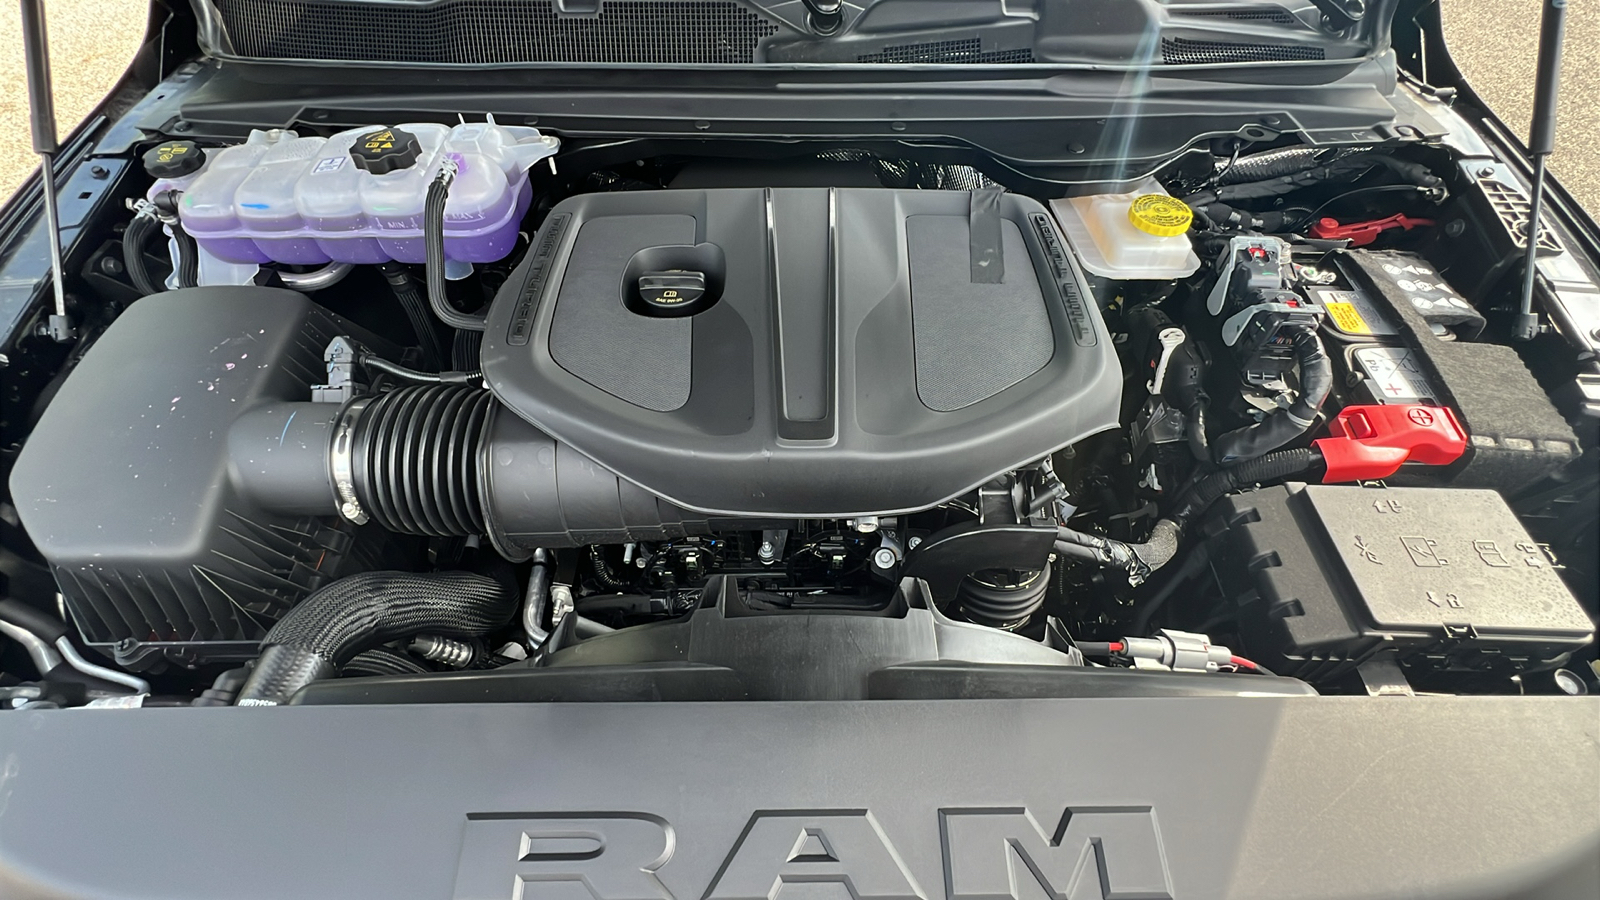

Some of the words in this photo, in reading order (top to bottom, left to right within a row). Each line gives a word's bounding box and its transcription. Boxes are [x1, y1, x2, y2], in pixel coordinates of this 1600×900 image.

[539, 213, 566, 258] TWIN
[1034, 214, 1068, 279] TURBO
[512, 261, 546, 339] TURBO
[1062, 282, 1090, 340] TWIN
[1364, 359, 1381, 372] Pb
[452, 805, 1175, 900] RAM
